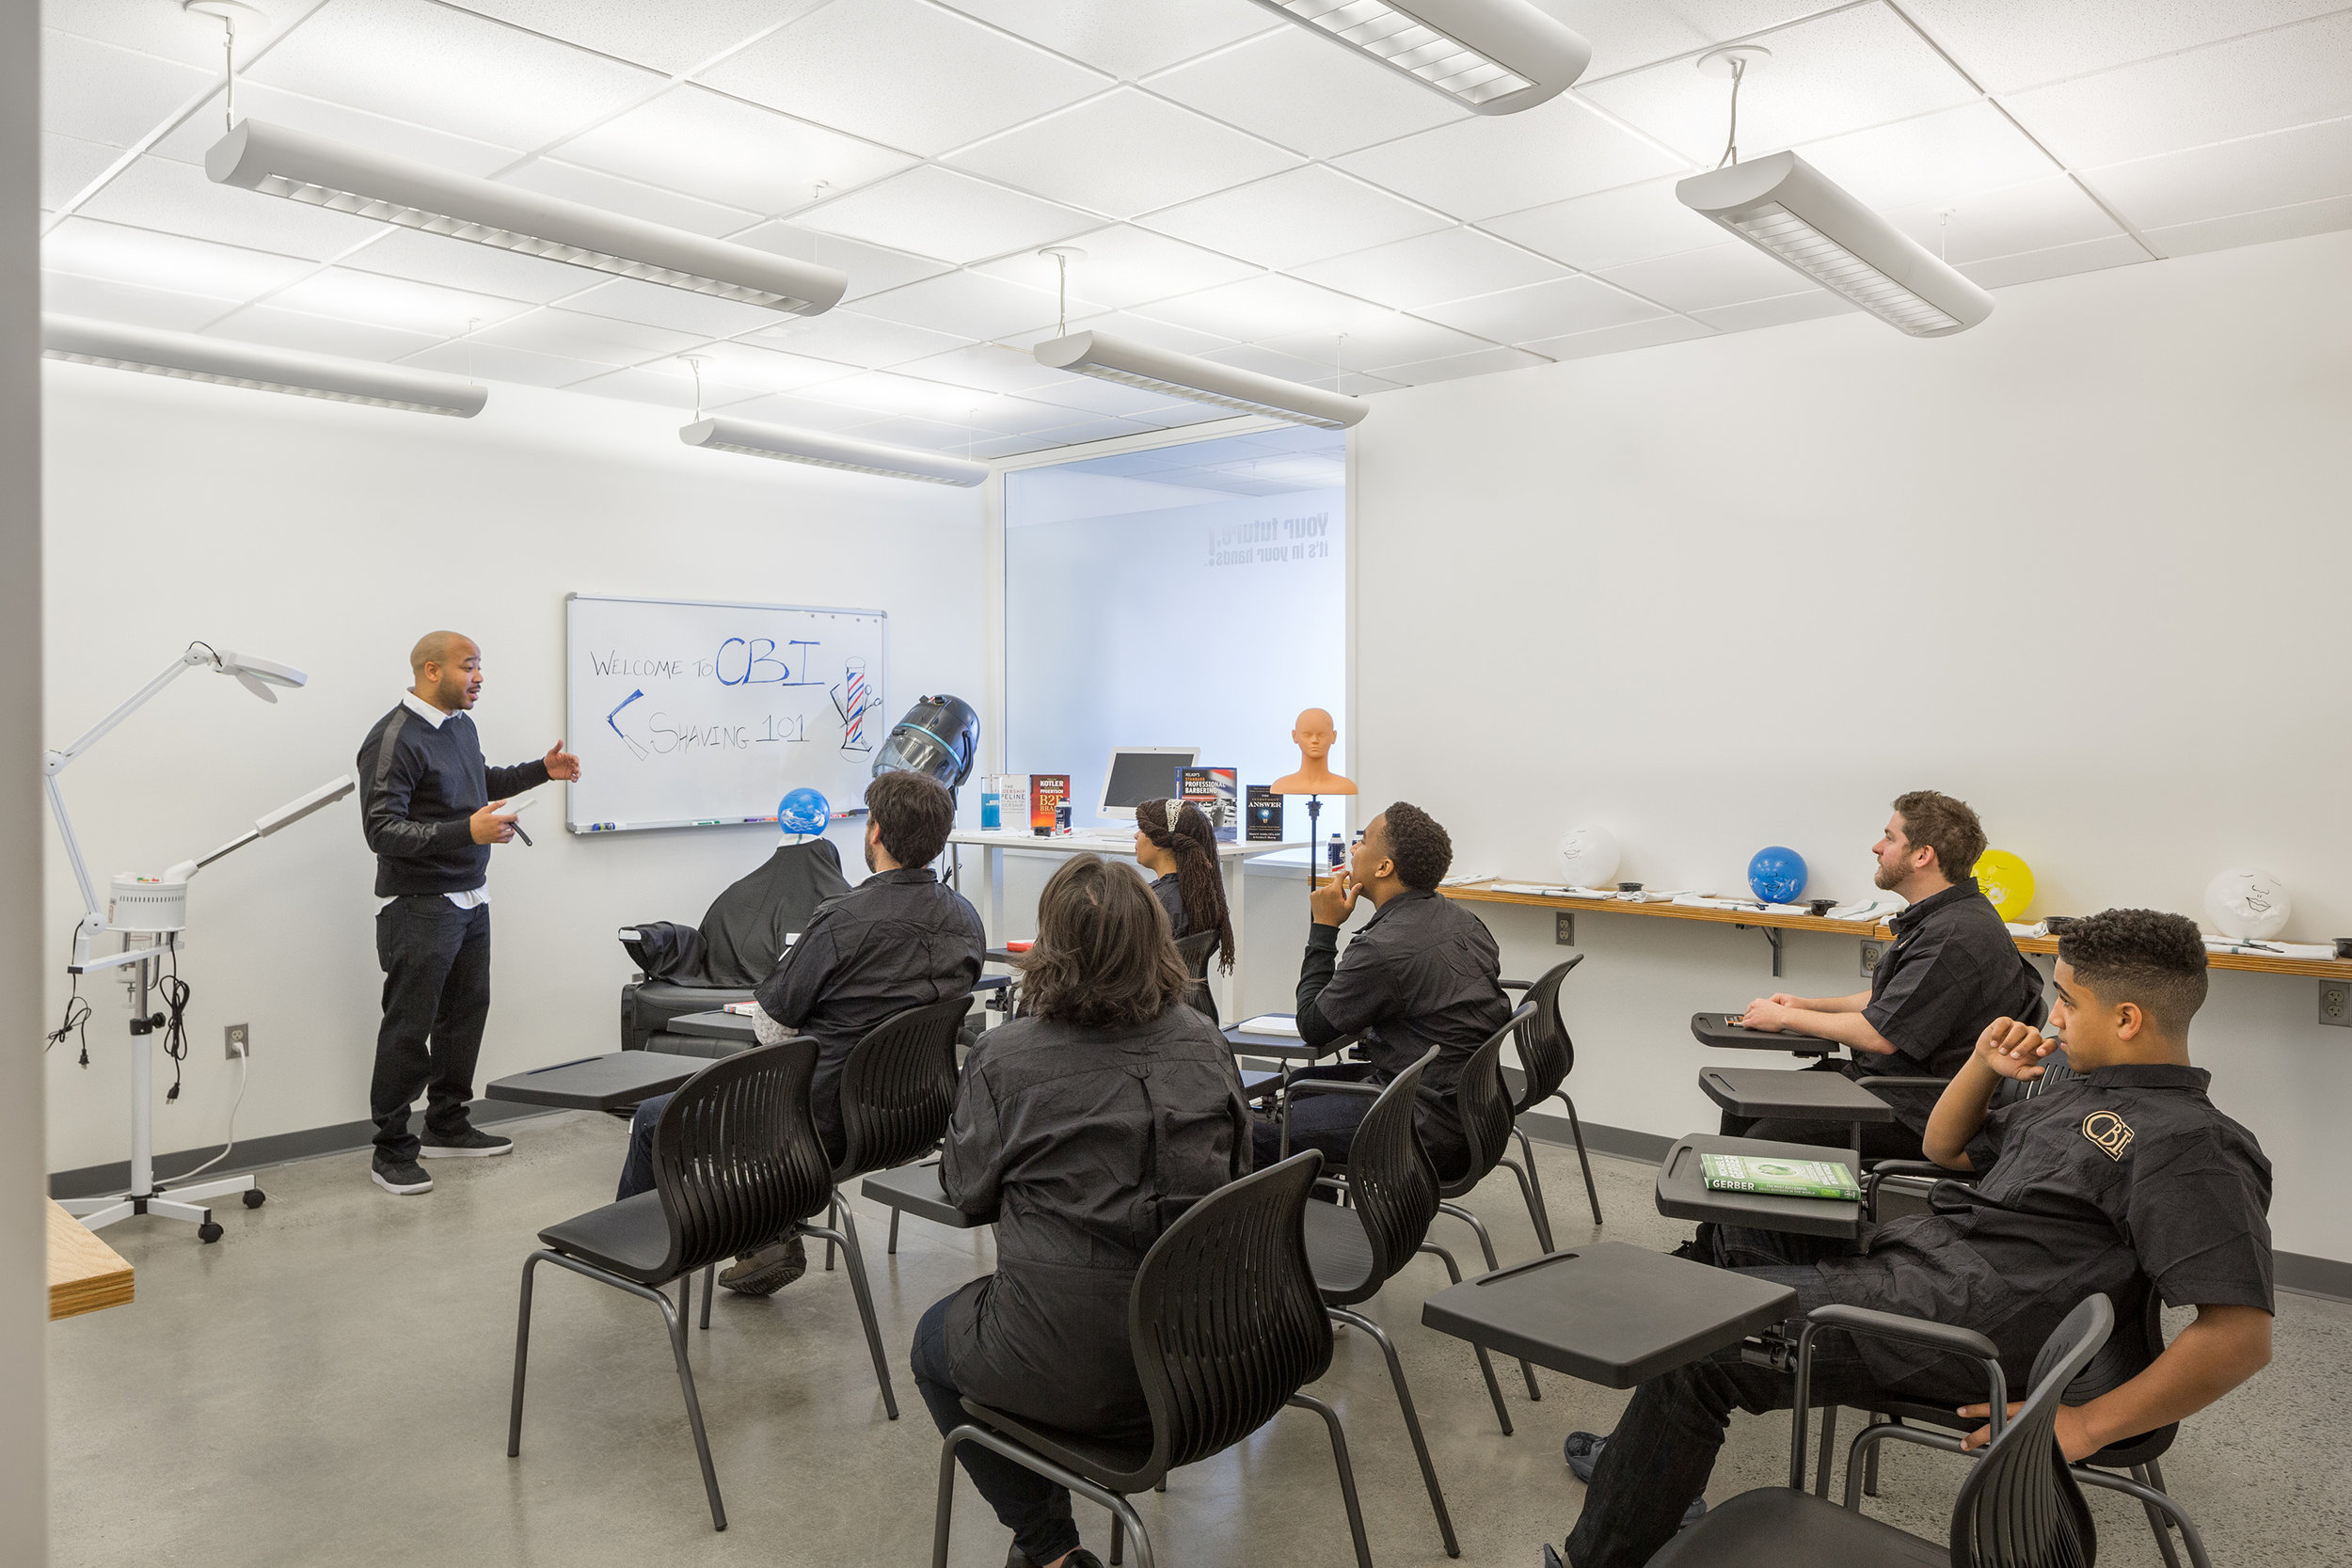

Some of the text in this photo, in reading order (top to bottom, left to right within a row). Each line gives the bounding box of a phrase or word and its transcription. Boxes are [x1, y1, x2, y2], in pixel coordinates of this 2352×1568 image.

[590, 649, 684, 679] WELCOME
[716, 637, 825, 686] CBI
[649, 711, 810, 753] SHAVING 101
[2086, 1114, 2132, 1156] CBI
[1712, 1180, 1755, 1191] GERBER
